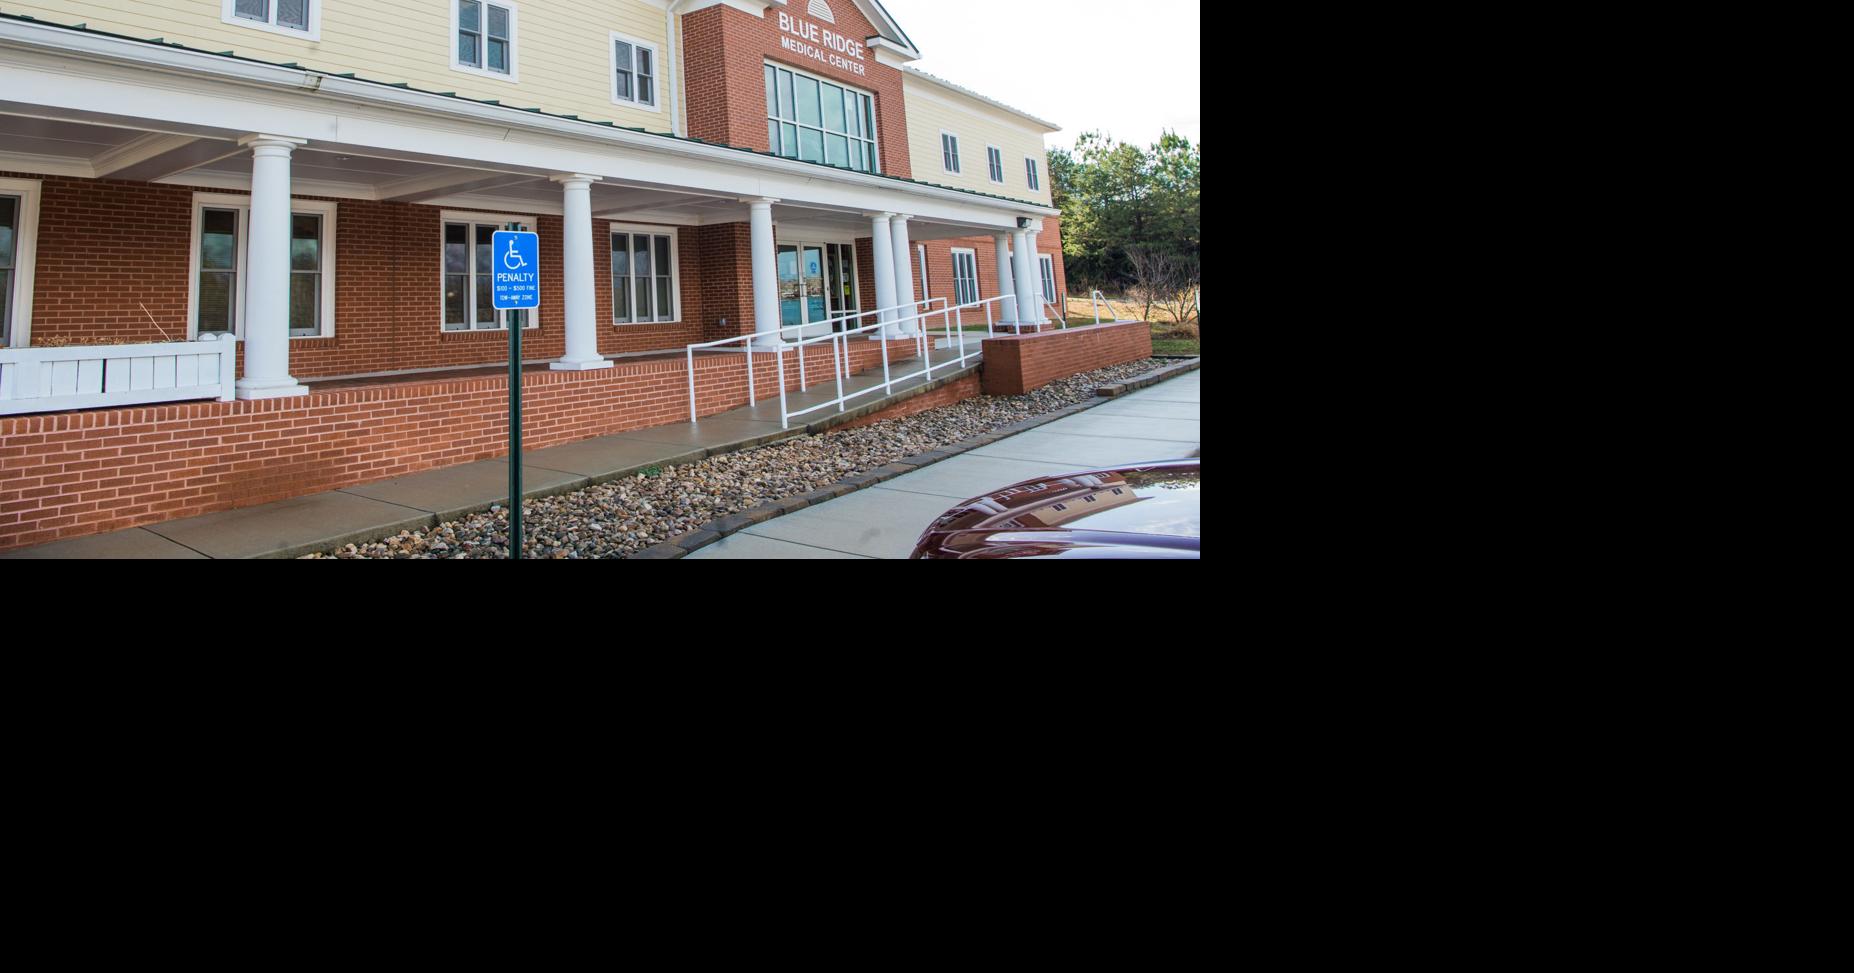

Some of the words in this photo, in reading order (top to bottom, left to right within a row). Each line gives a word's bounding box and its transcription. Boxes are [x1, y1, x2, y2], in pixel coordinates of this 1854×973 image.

[778, 11, 820, 43] BLUE
[822, 28, 865, 60] RIDGE
[781, 35, 827, 62] MEDICAL
[828, 53, 866, 76] CENTER
[497, 272, 534, 282] PENALTY
